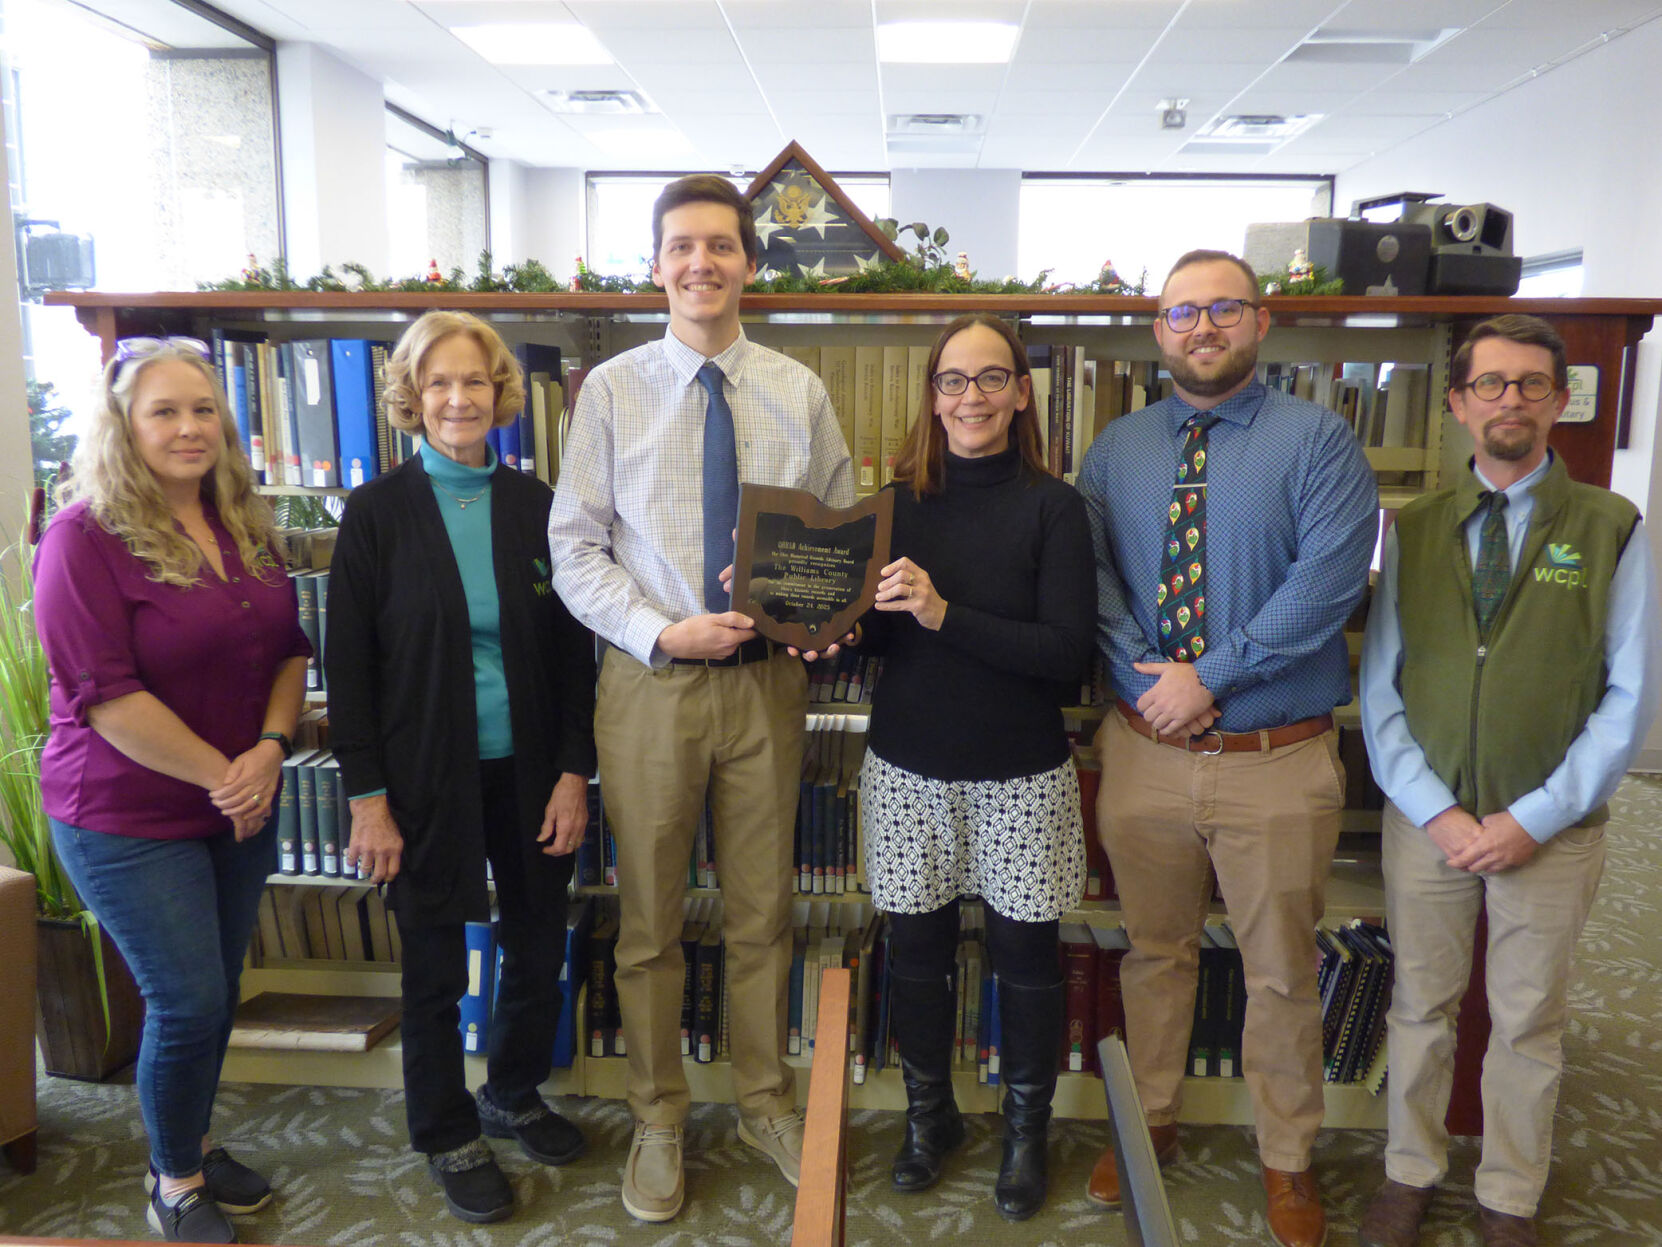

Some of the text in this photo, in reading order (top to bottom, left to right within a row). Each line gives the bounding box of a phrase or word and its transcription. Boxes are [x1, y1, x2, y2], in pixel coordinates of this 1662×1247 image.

[774, 563, 848, 579] The Williams County
[783, 571, 836, 586] Public Library
[1534, 567, 1588, 590] wcpl
[785, 600, 804, 608] October
